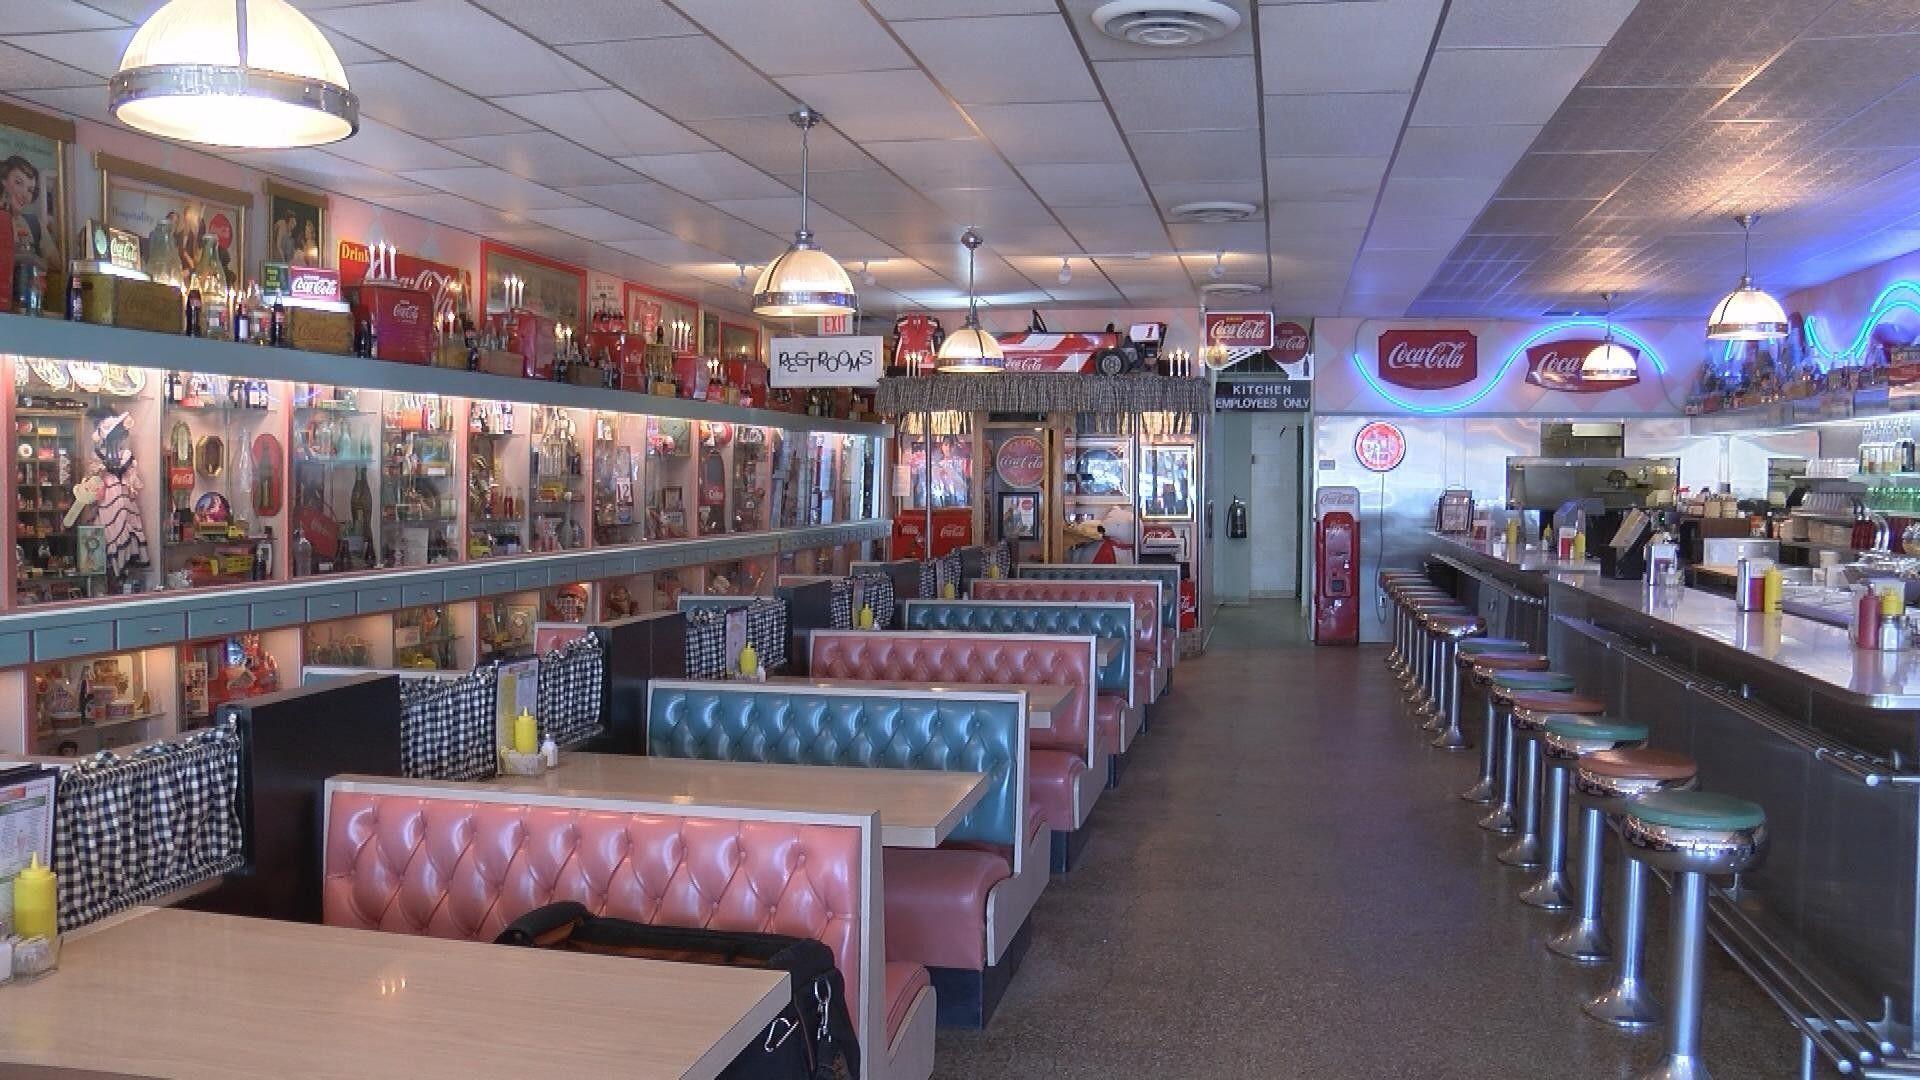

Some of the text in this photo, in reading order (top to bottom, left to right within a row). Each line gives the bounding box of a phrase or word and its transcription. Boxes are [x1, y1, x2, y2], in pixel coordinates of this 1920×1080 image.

[824, 316, 846, 333] EXIT
[779, 350, 873, 373] RESTROOMS
[1232, 385, 1292, 395] KITCHEN
[1215, 398, 1310, 409] EMPLOYEES ONLY
